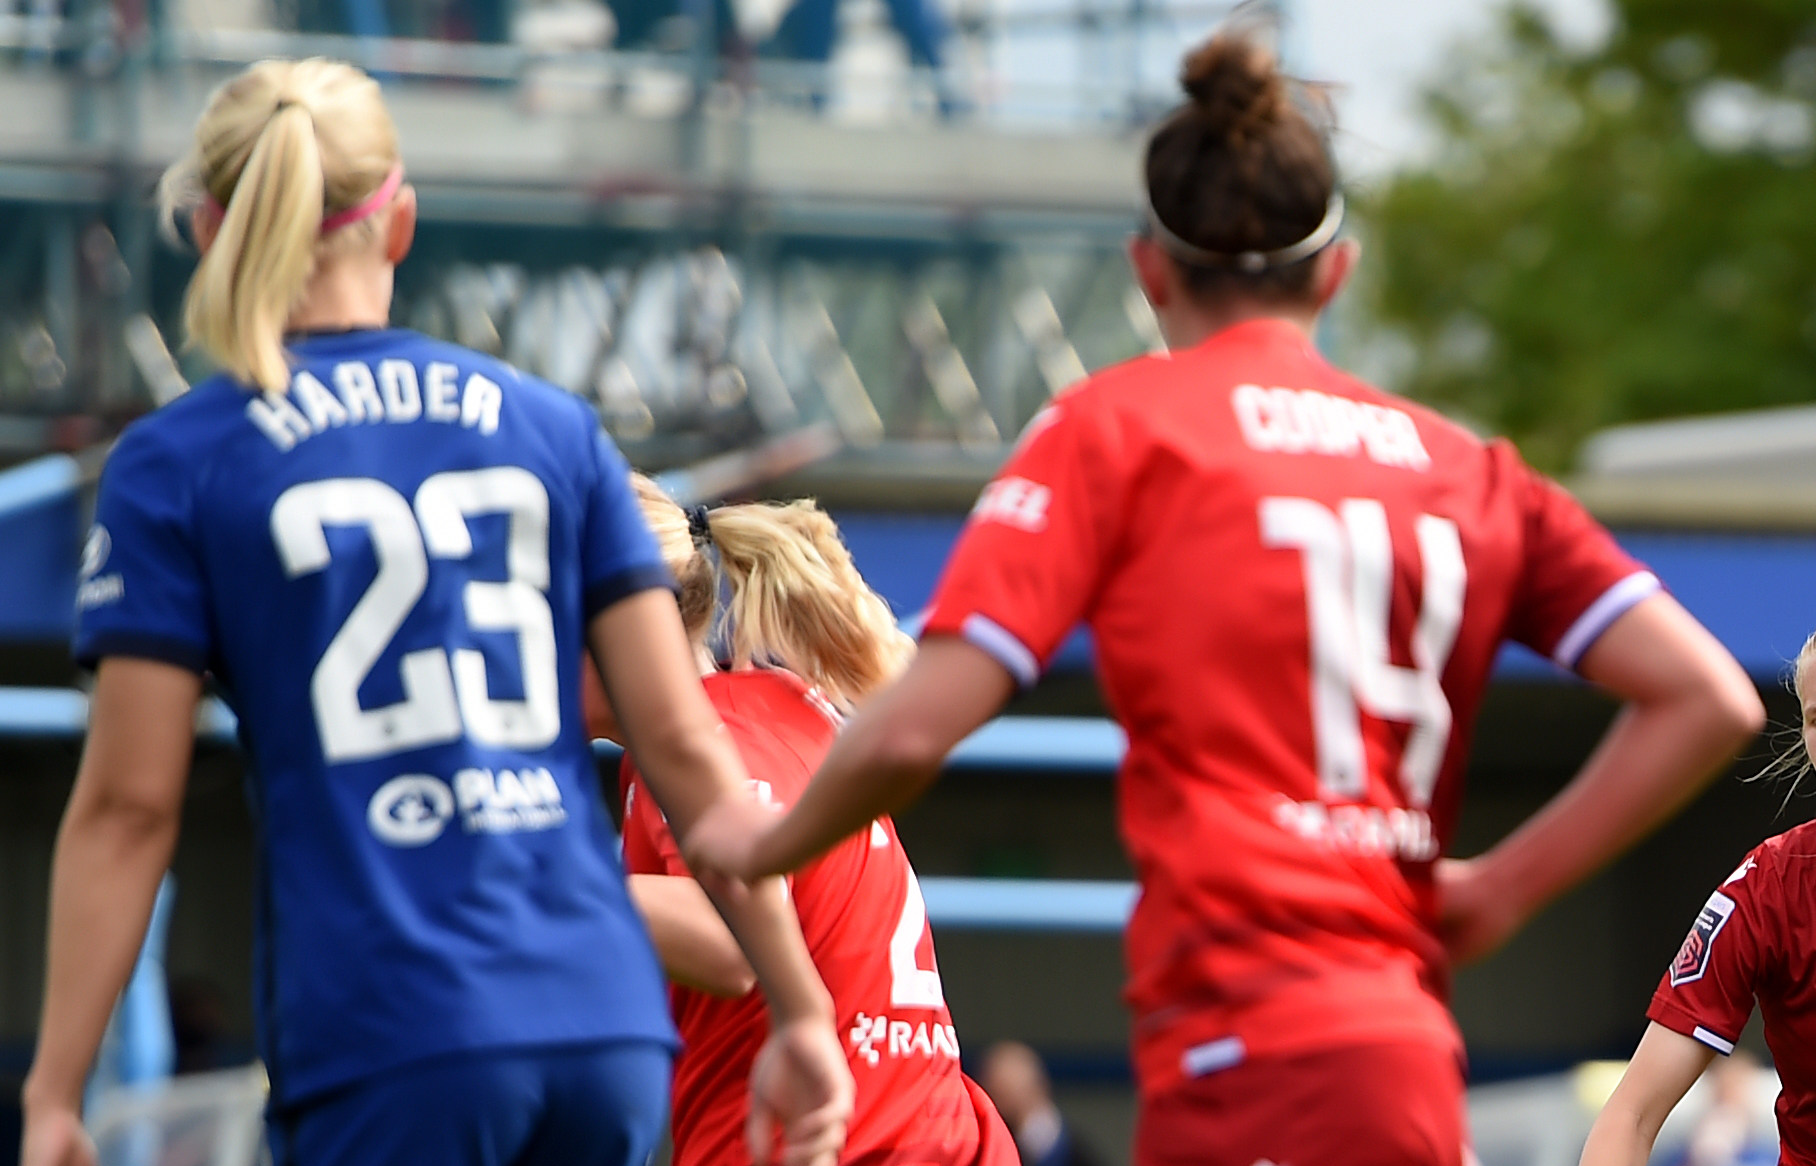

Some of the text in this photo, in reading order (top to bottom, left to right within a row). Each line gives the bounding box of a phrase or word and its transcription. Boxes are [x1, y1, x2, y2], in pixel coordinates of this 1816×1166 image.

[246, 359, 502, 452] HARDER
[1229, 383, 1434, 474] COOPER
[271, 466, 560, 765] 23
[1259, 497, 1466, 808] 14
